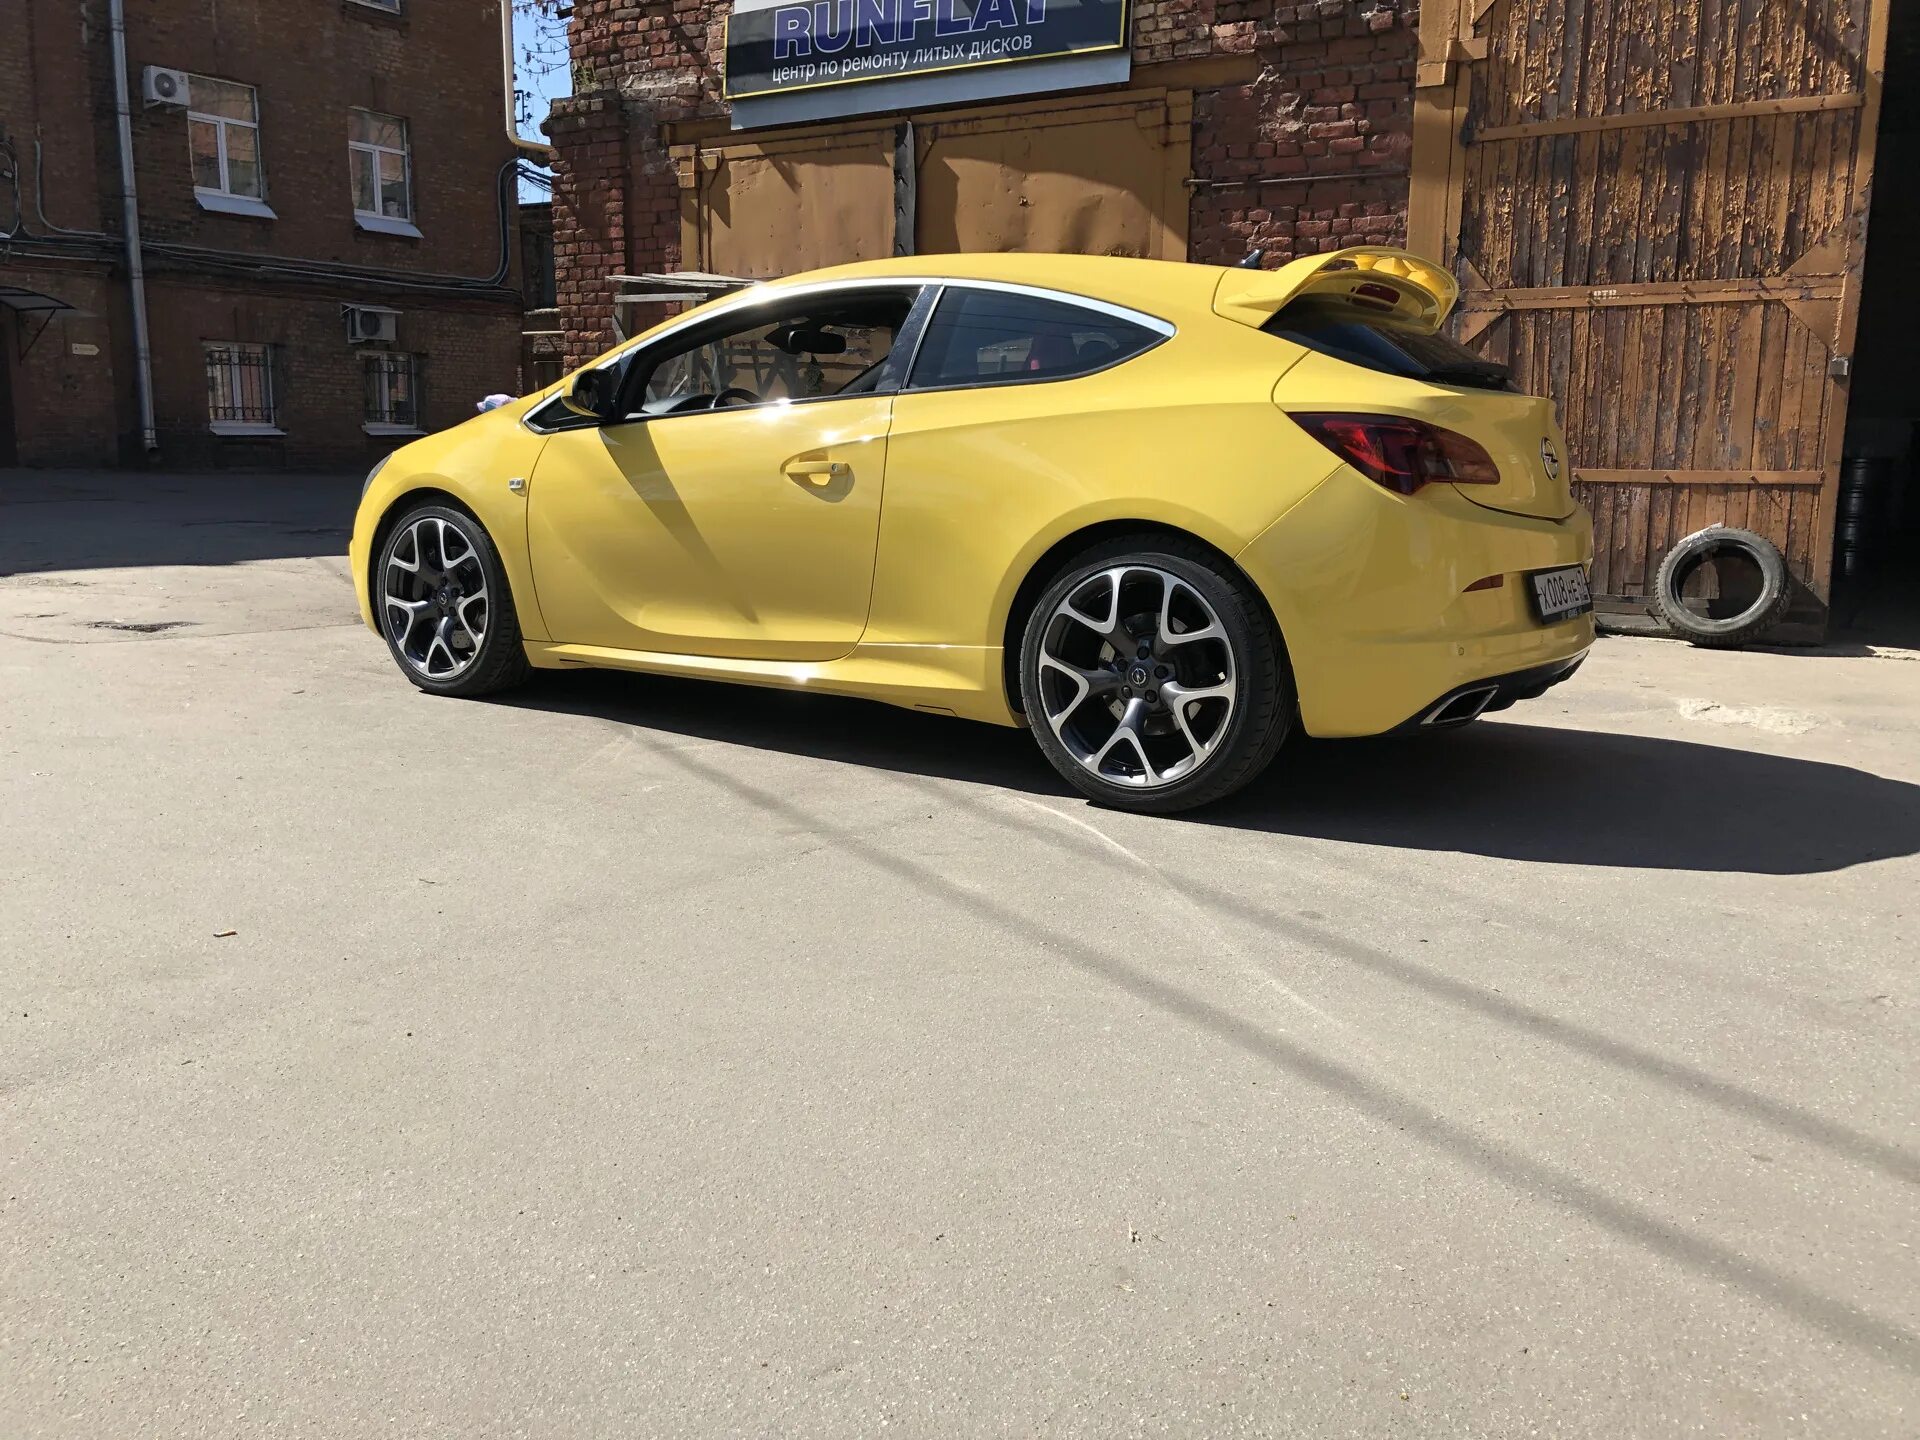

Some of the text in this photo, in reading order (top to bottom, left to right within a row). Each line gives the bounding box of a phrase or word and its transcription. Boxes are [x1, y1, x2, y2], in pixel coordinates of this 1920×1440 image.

[772, 35, 1032, 84] центр по ремонту литых дисков
